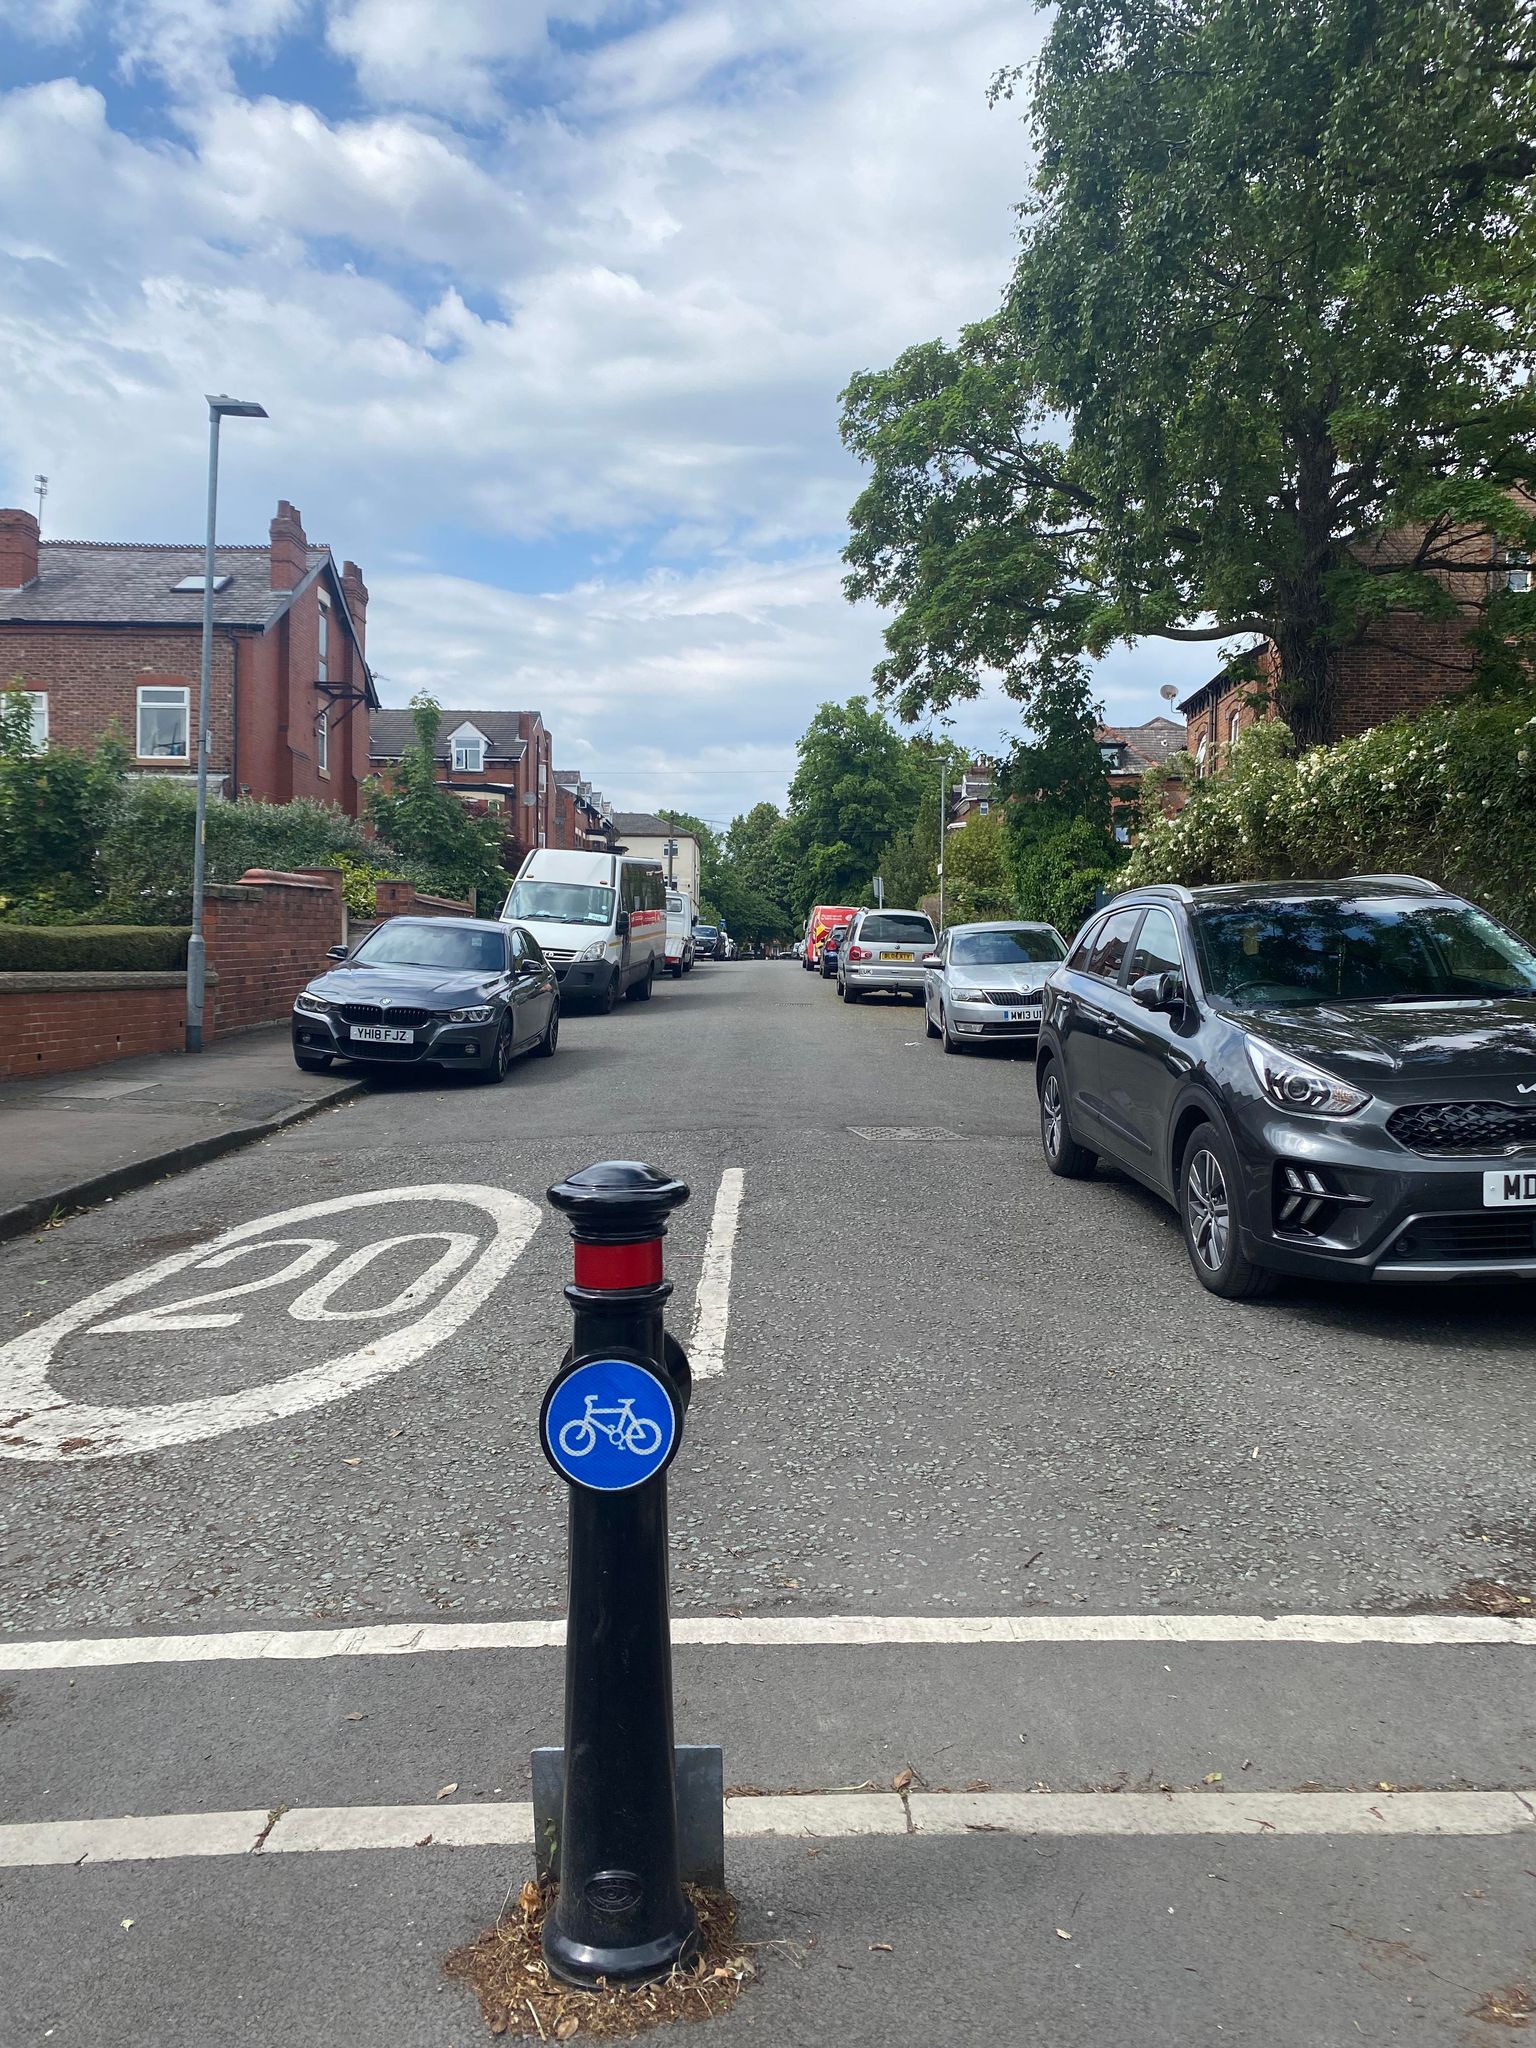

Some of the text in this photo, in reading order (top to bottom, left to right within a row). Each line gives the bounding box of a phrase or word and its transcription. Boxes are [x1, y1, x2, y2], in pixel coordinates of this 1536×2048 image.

[1011, 1011, 1031, 1020] MW13
[357, 1028, 406, 1041] YH18 FJZ
[86, 1233, 479, 1333] 20
